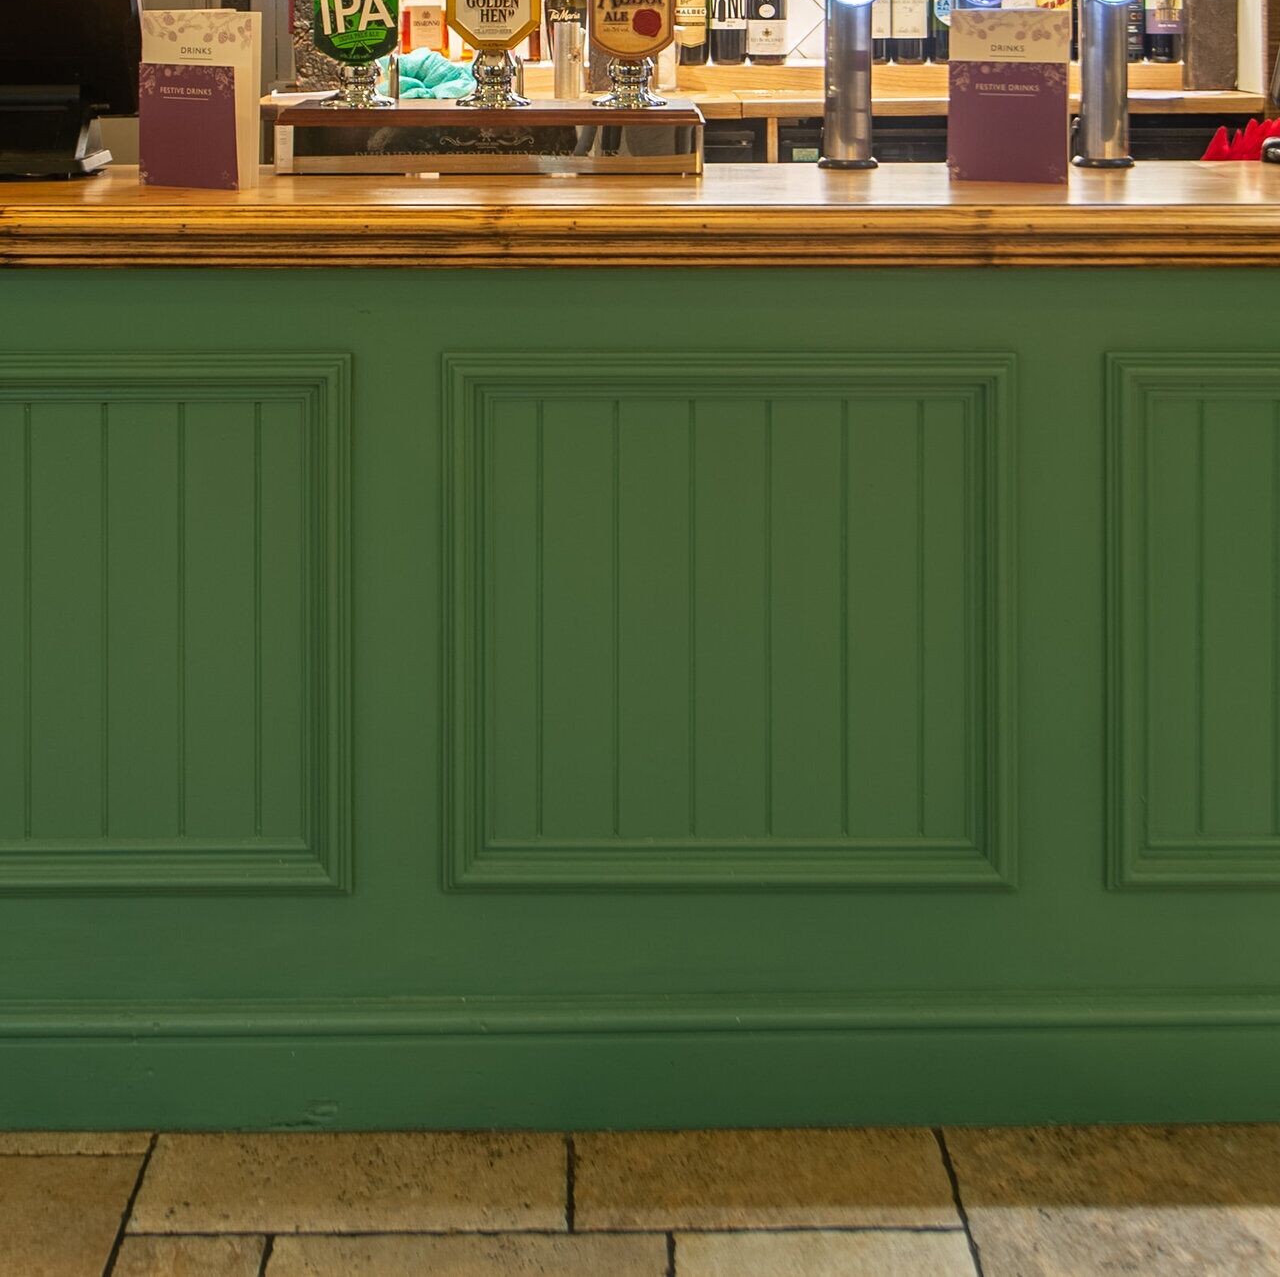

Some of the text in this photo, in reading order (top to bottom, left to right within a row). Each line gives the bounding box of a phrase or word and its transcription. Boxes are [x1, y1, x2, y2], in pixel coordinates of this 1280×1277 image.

[604, 11, 629, 23] ALE
[180, 46, 212, 55] DRINKS
[990, 44, 1026, 53] DRINKS
[160, 86, 212, 96] FESTIVE DRINKS
[975, 83, 1040, 92] FESTIVE DRINKS
